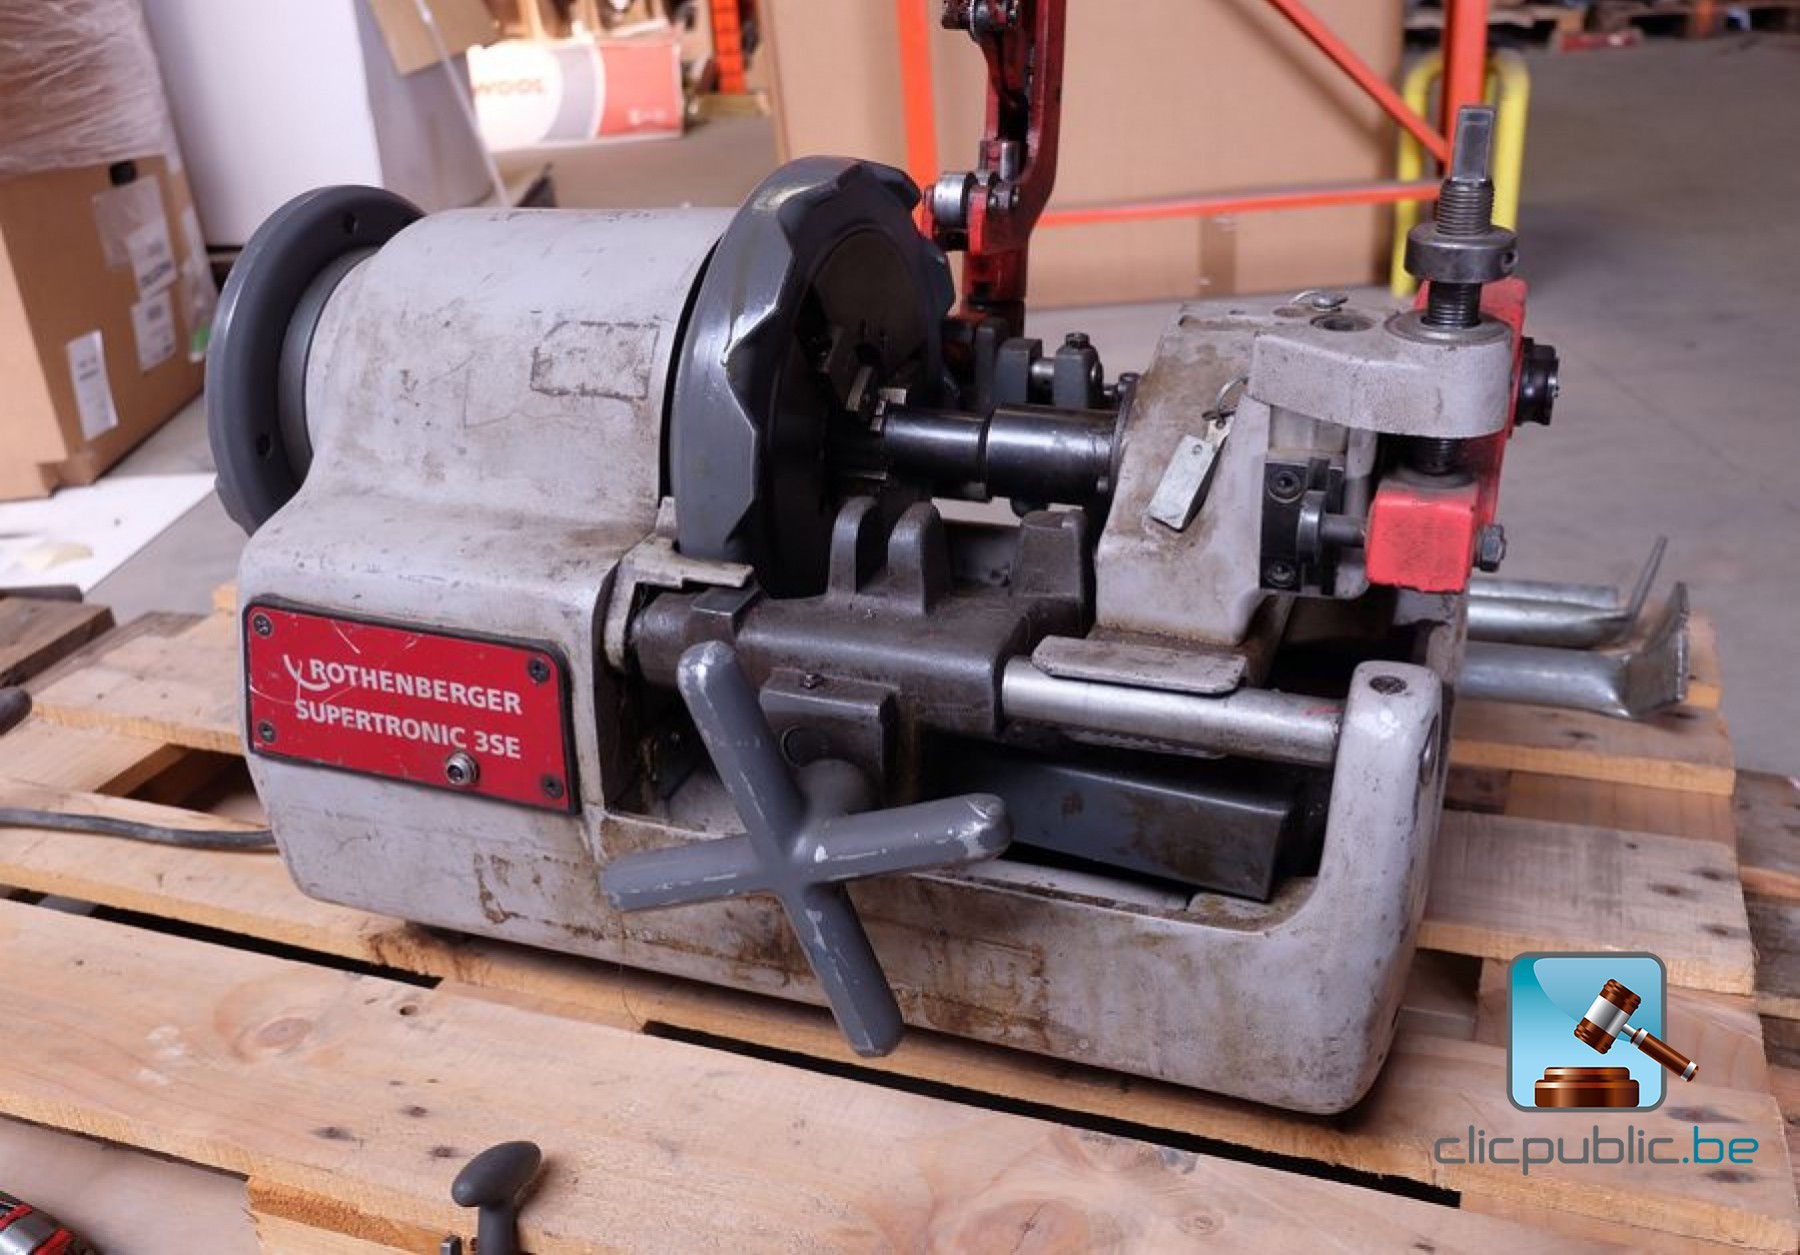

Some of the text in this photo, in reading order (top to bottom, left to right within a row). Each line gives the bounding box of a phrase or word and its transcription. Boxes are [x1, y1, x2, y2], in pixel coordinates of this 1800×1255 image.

[309, 658, 523, 716] ROTHENBERGER
[295, 698, 522, 759] SUPERTRONIC 3SE
